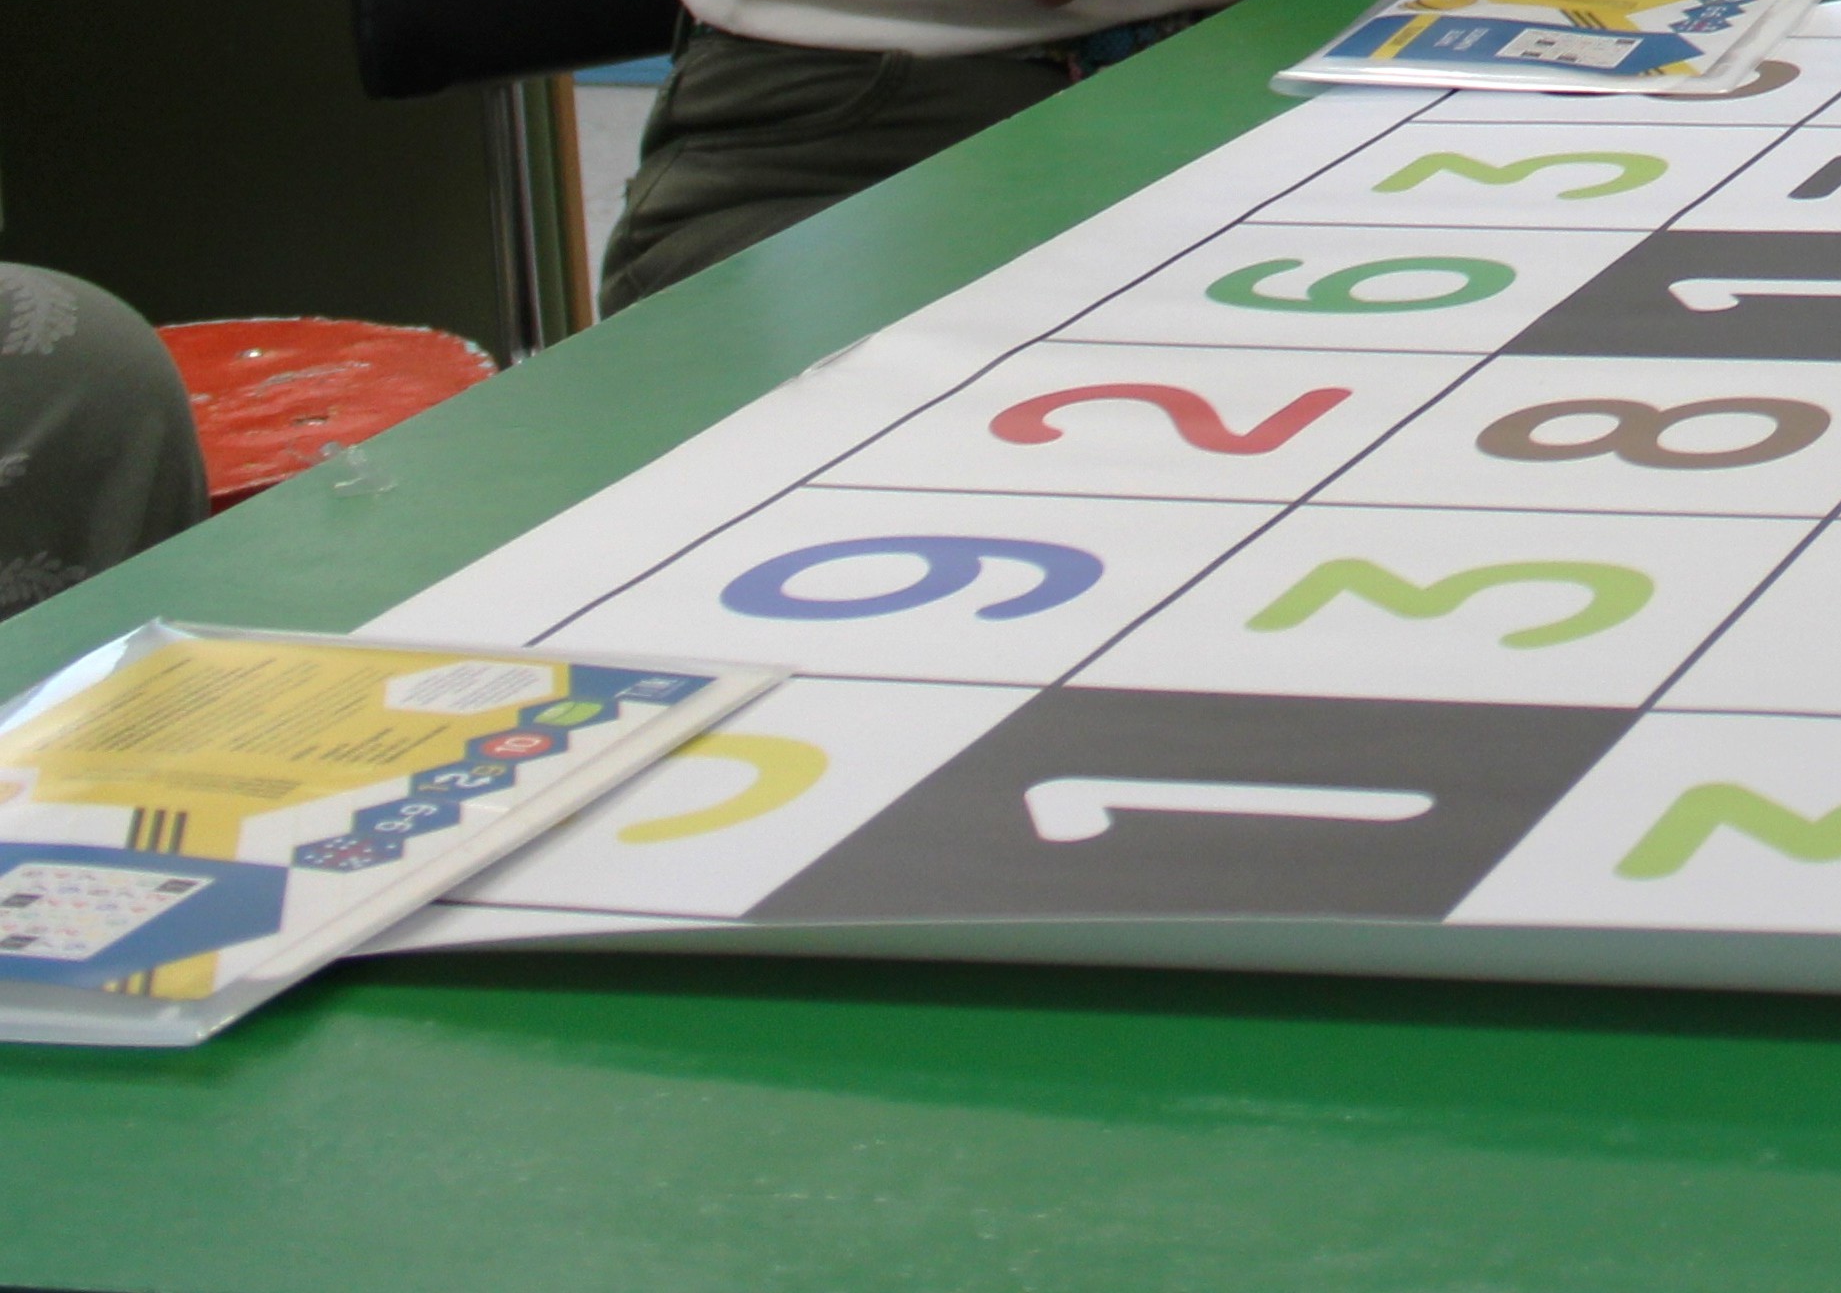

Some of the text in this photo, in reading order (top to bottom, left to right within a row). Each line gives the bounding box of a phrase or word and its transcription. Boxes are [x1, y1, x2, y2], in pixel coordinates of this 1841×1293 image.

[1376, 151, 1667, 199] 3
[1206, 256, 1517, 315] 6
[990, 382, 1352, 456] 2
[1476, 397, 1832, 471] 8
[721, 534, 1105, 620] 9
[1244, 557, 1654, 651] 3
[1026, 775, 1435, 842] 1
